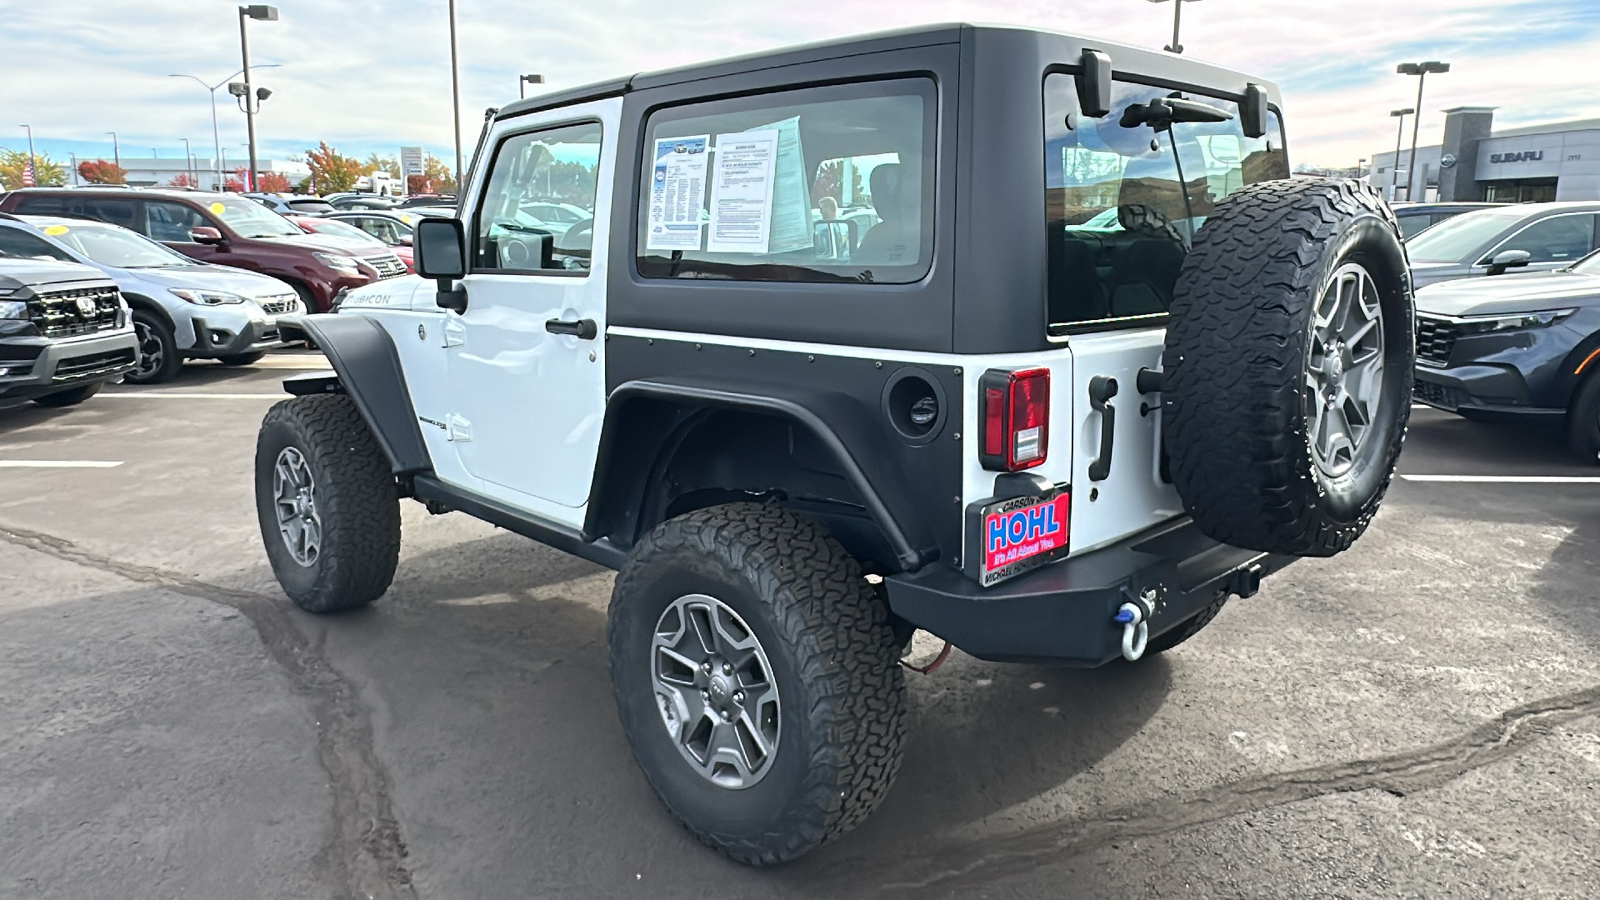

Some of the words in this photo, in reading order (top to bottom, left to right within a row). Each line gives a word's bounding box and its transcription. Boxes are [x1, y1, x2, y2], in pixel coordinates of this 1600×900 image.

[1490, 151, 1543, 163] SUBARU
[345, 294, 391, 304] RUBICON
[1003, 496, 1035, 512] CARSON
[989, 503, 1059, 553] HOHL
[1018, 542, 1039, 557] About
[985, 566, 1012, 584] MICHAEL
